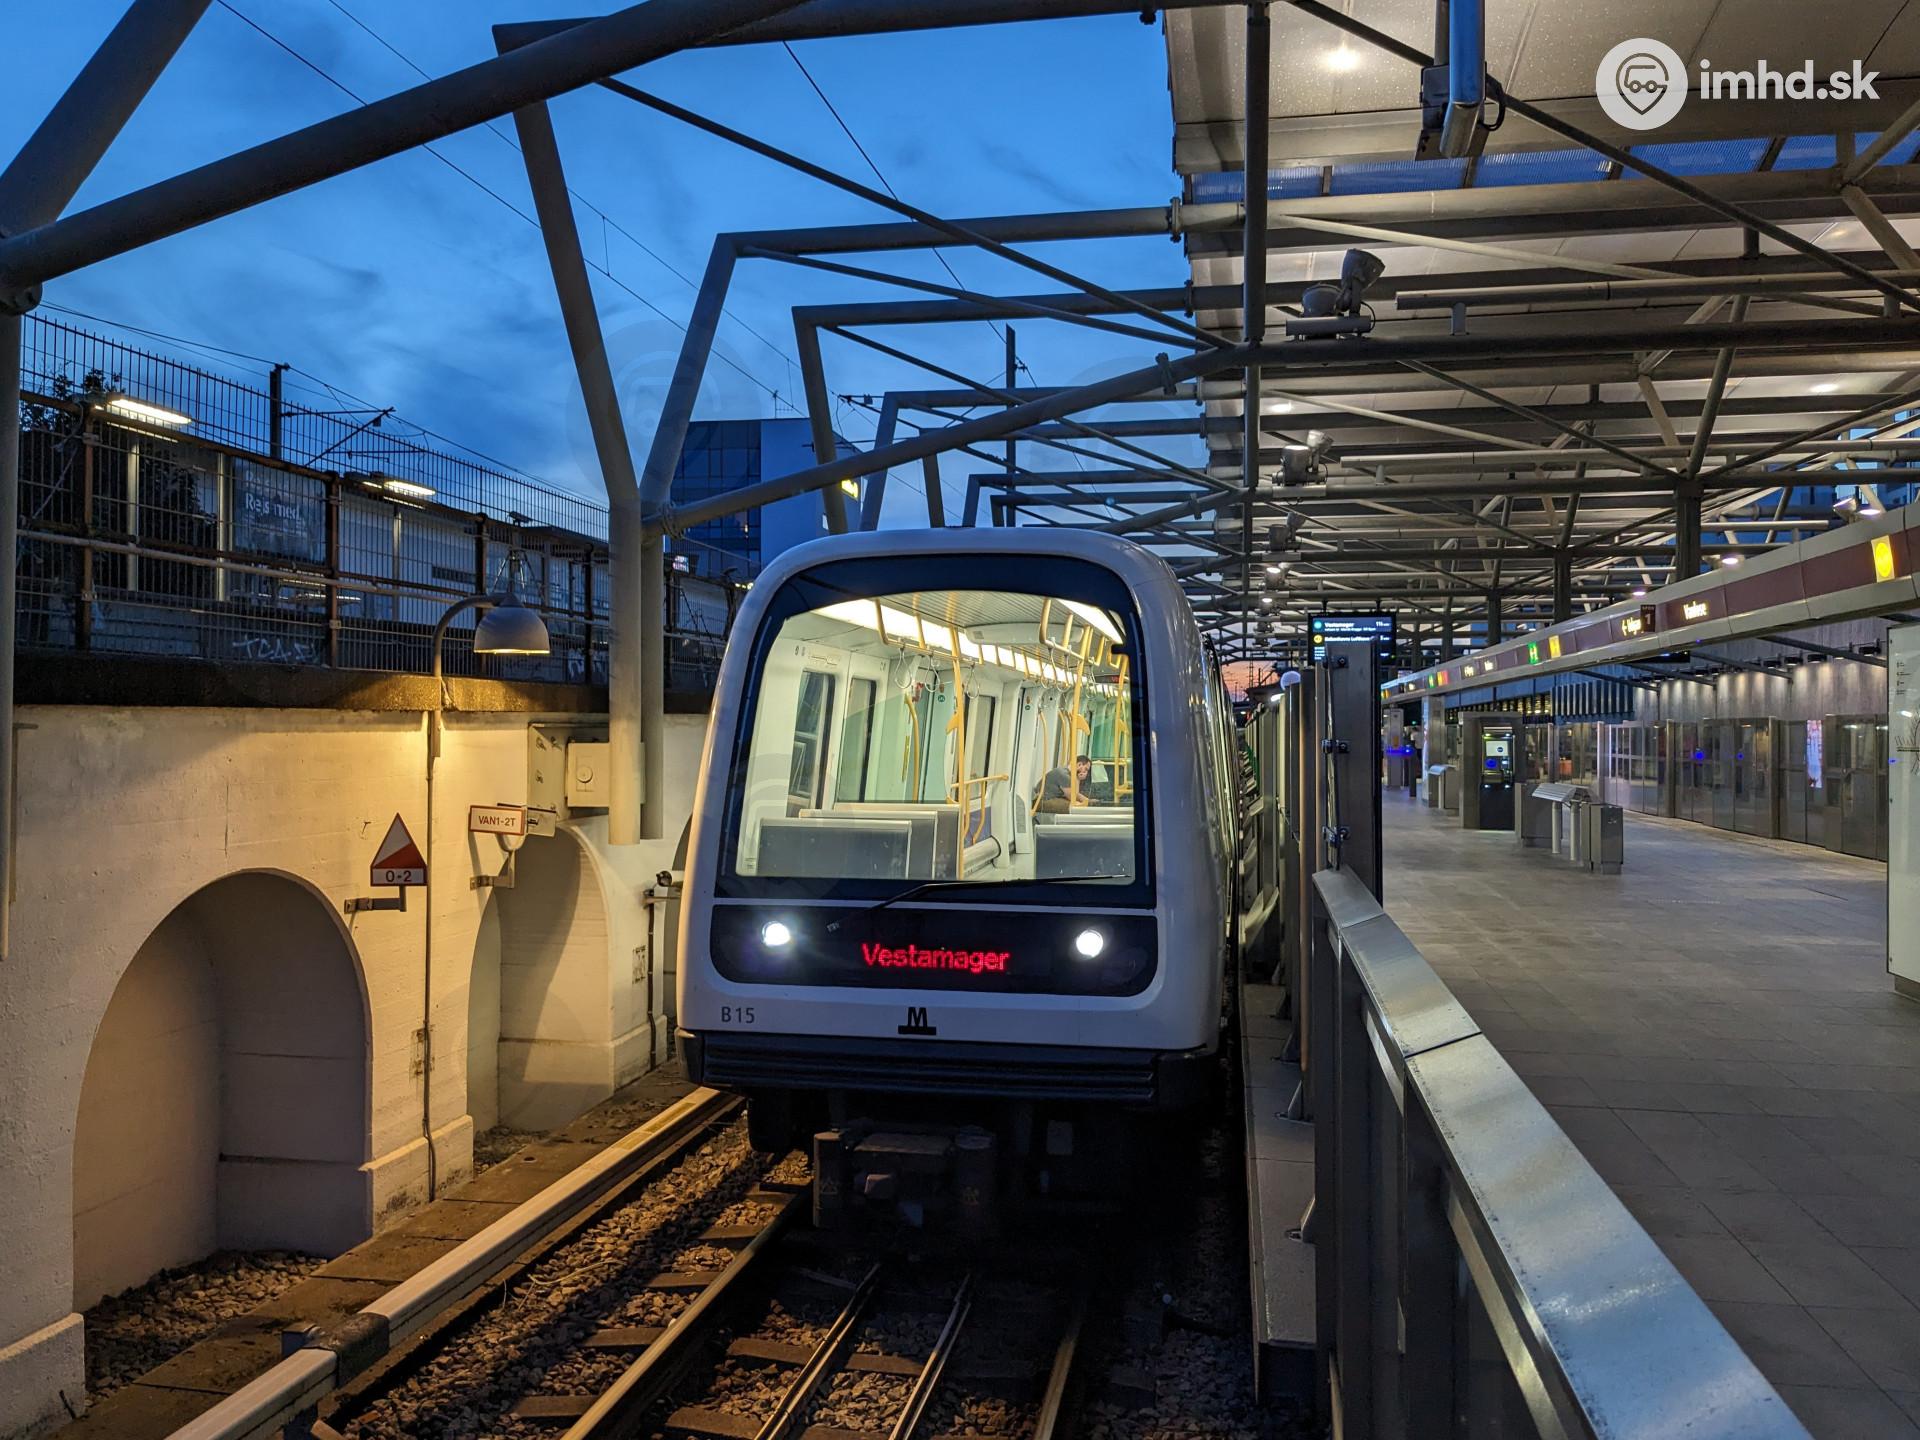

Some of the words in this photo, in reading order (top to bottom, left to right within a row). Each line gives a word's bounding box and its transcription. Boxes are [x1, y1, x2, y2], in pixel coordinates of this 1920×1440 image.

[1645, 613, 1651, 625] 1
[478, 815, 517, 827] VAN1-2T
[385, 870, 412, 882] 0-2
[863, 943, 1011, 975] Vestamager
